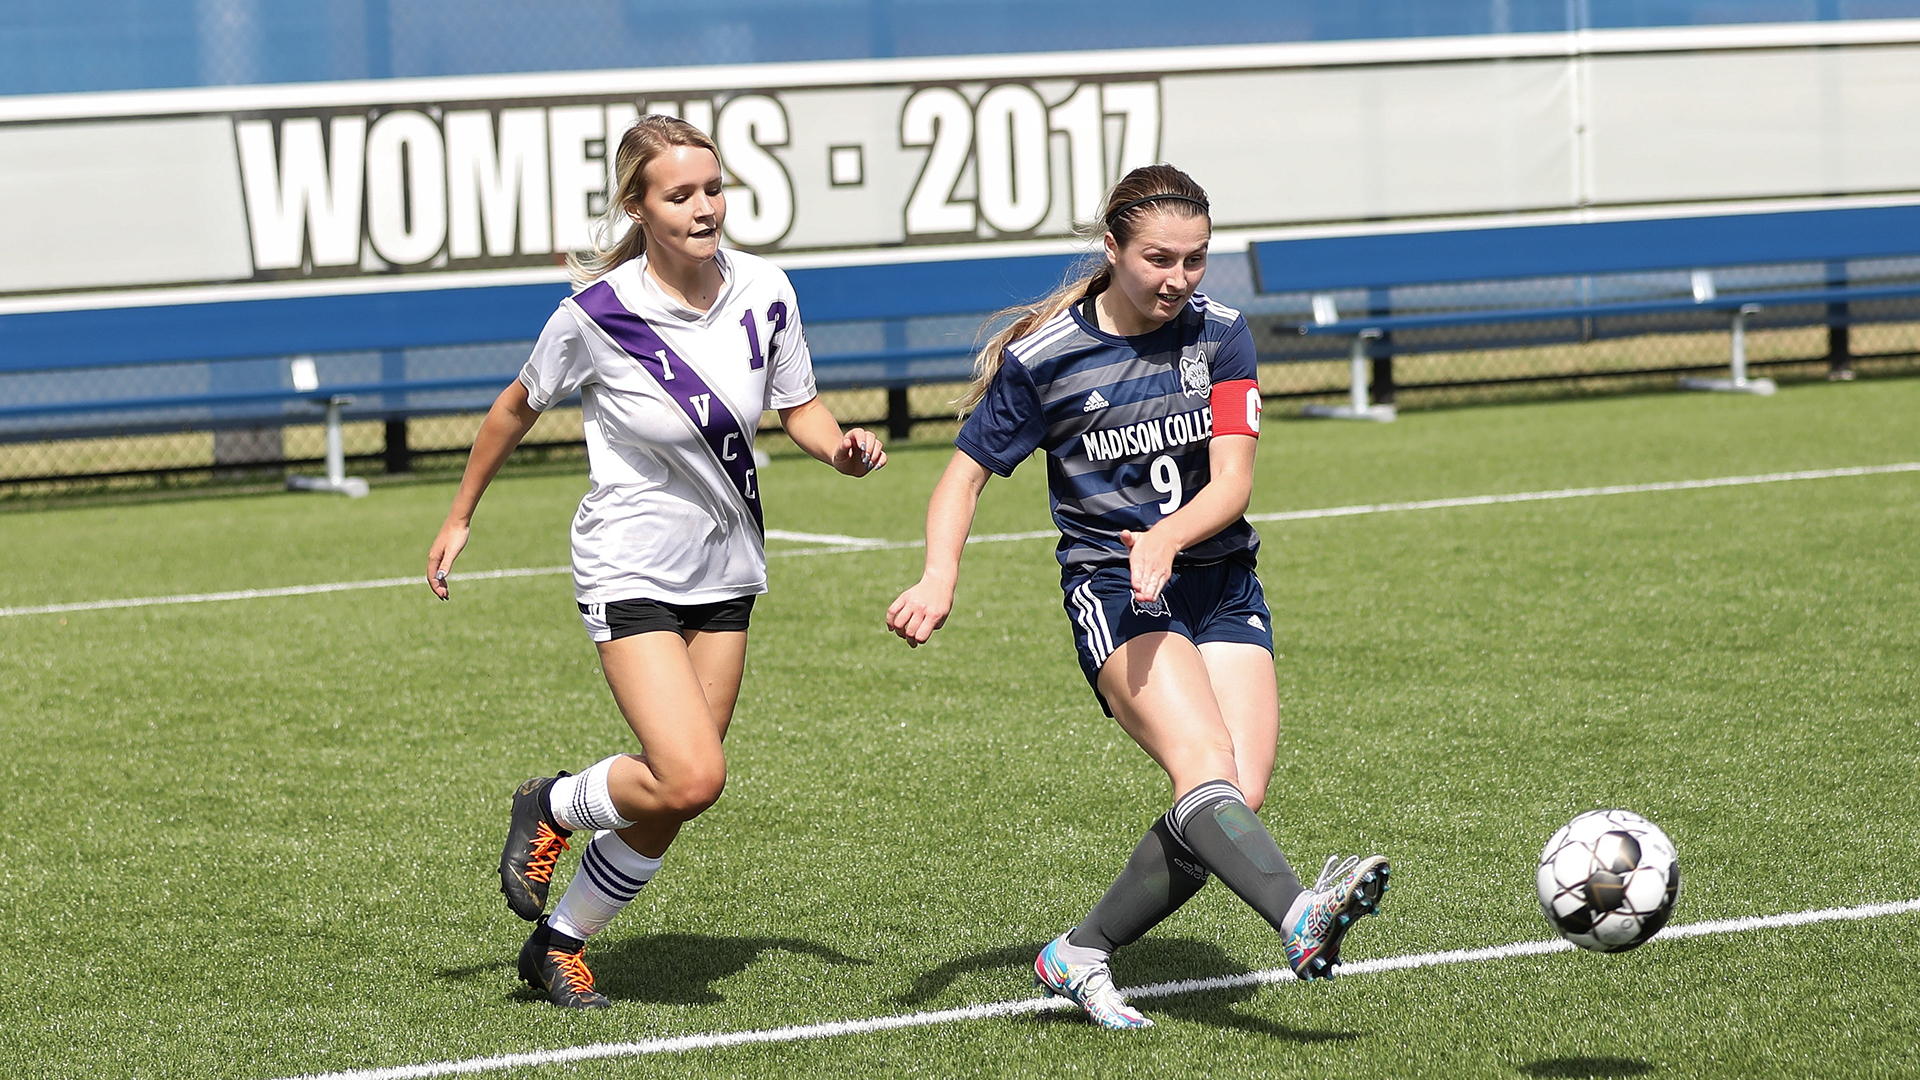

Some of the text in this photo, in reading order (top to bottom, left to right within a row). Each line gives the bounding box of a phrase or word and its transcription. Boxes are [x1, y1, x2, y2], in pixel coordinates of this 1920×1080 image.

[902, 80, 1161, 234] 2017
[739, 300, 788, 373] 12
[1081, 405, 1213, 463] MADISON COLLE
[1246, 387, 1261, 433] C
[1149, 454, 1183, 516] 9
